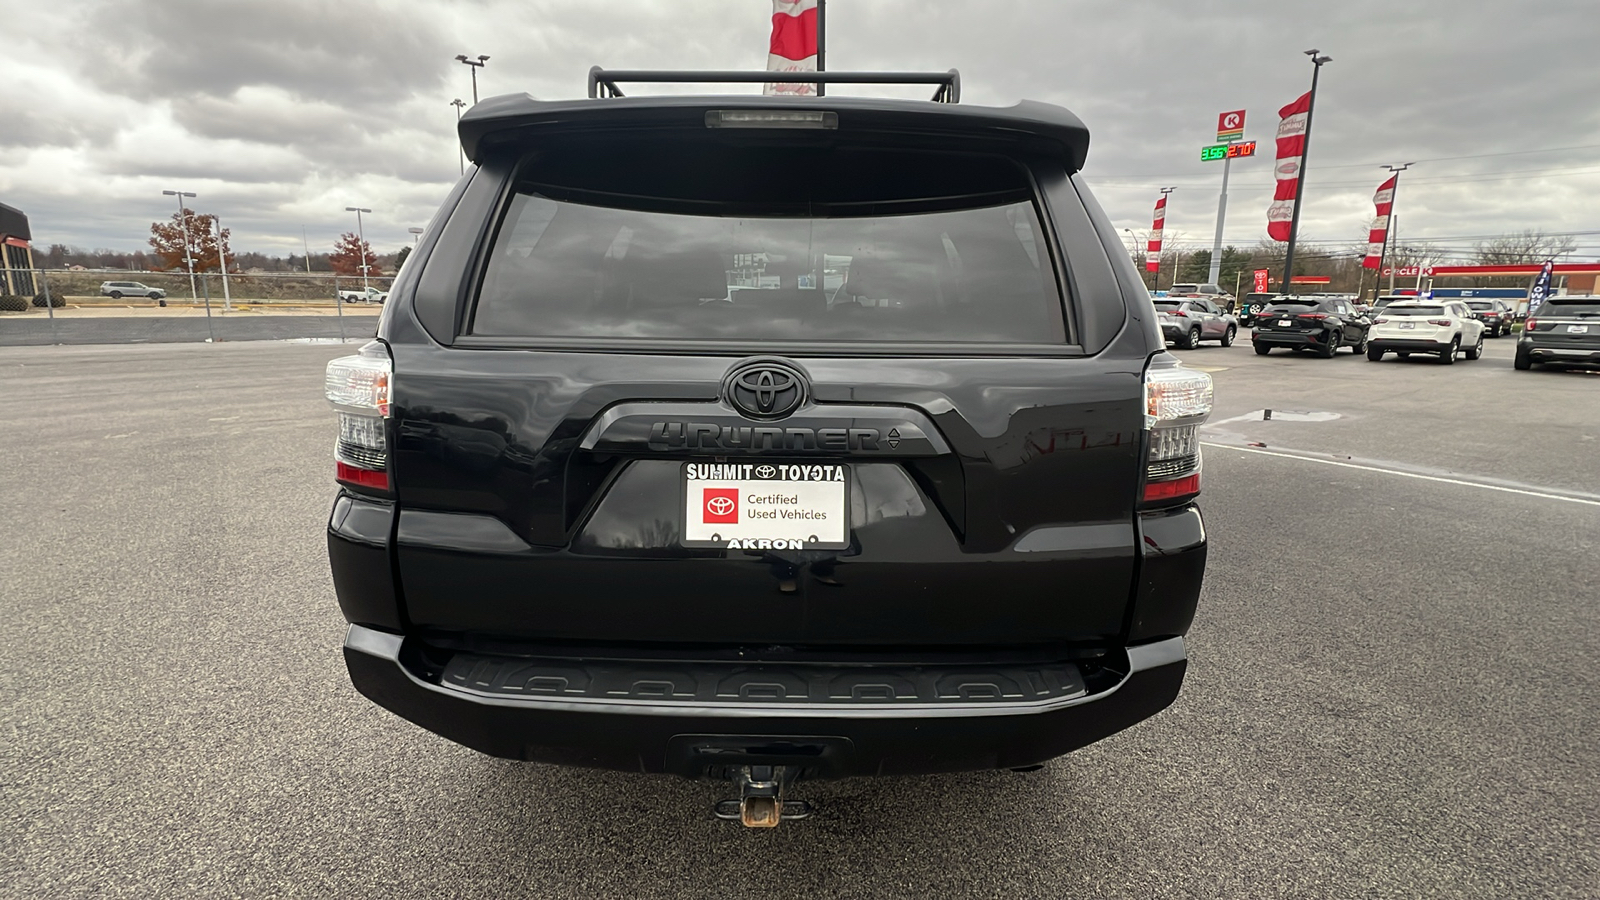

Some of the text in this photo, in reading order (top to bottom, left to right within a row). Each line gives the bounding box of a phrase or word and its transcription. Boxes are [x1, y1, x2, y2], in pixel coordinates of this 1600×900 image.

[686, 463, 845, 481] SUMMIT TOYOTA
[747, 494, 798, 505] Certified
[747, 509, 827, 520] Used Vehicles
[727, 538, 803, 550] AKRON
